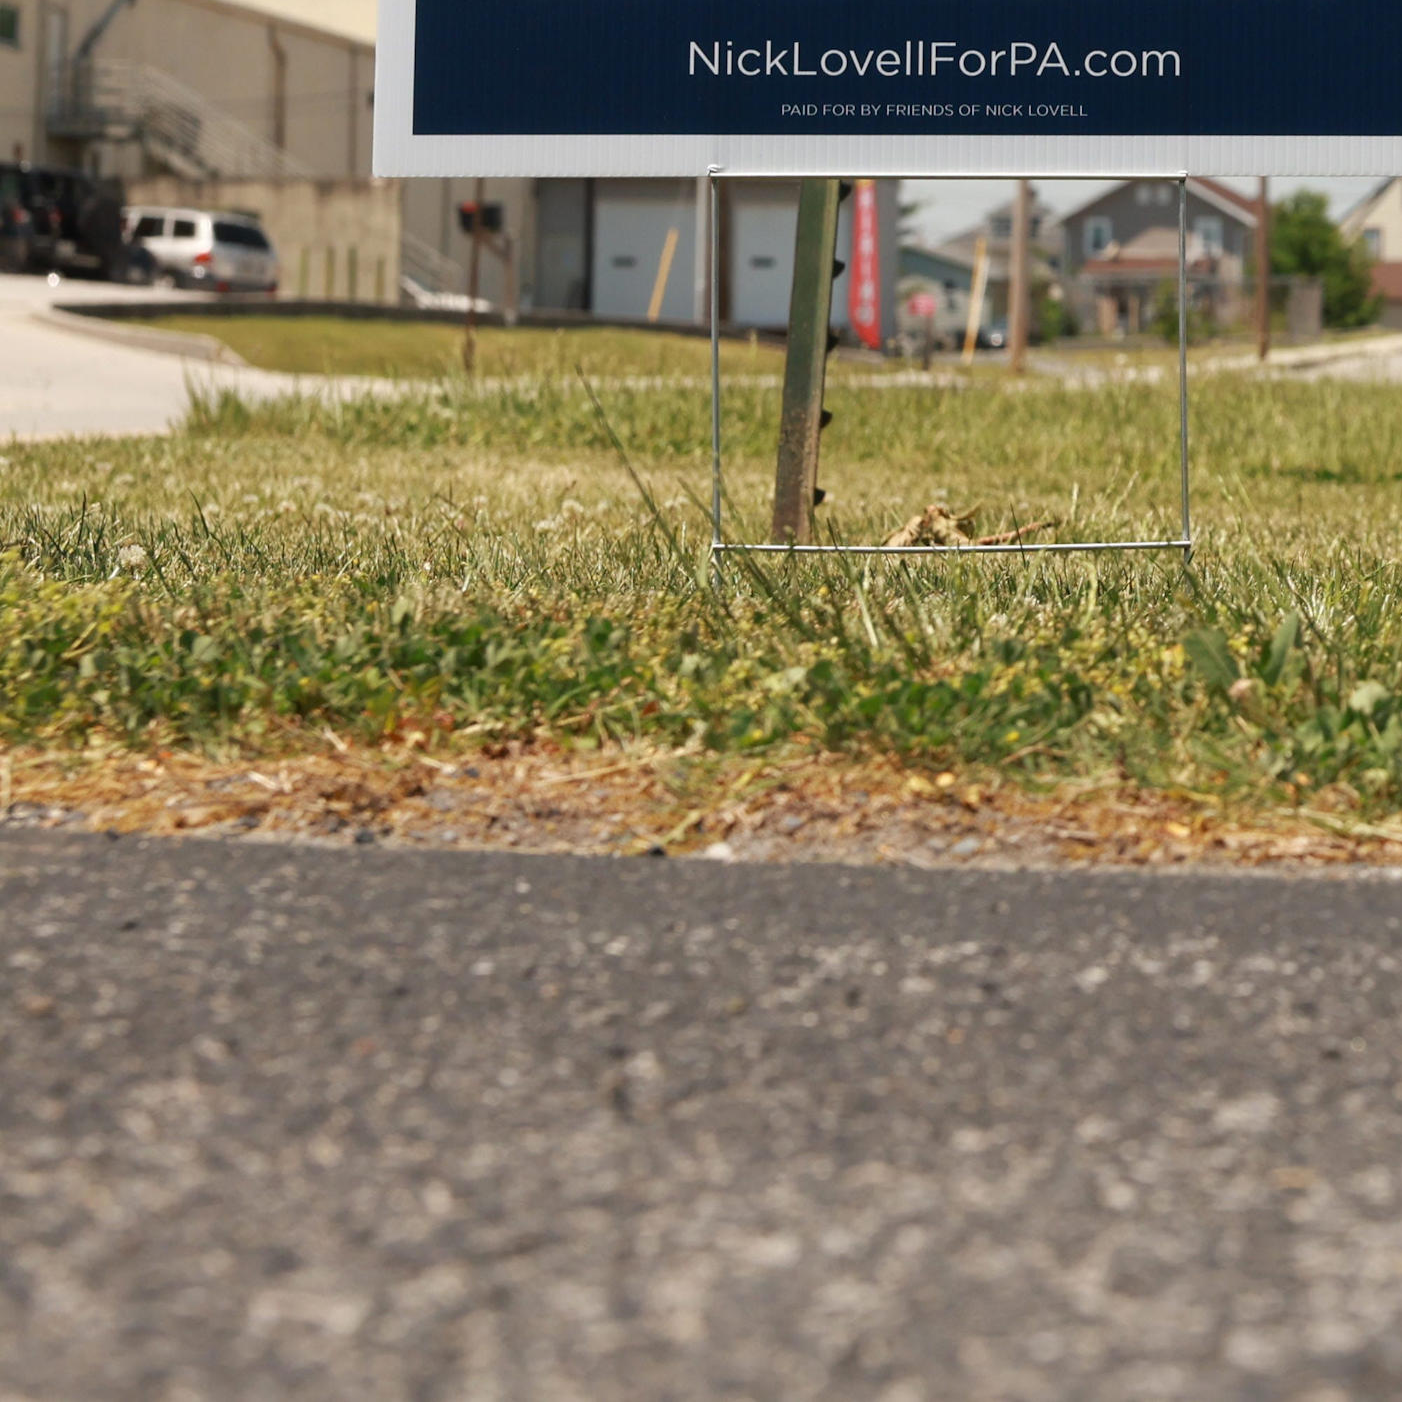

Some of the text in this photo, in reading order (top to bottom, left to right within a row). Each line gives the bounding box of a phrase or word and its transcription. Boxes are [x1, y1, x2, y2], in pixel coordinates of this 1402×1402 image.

[688, 39, 1181, 78] NickLovellForPA.com
[782, 104, 1087, 116] PAID FOR BY FRIENDS OF NICK LOVELL
